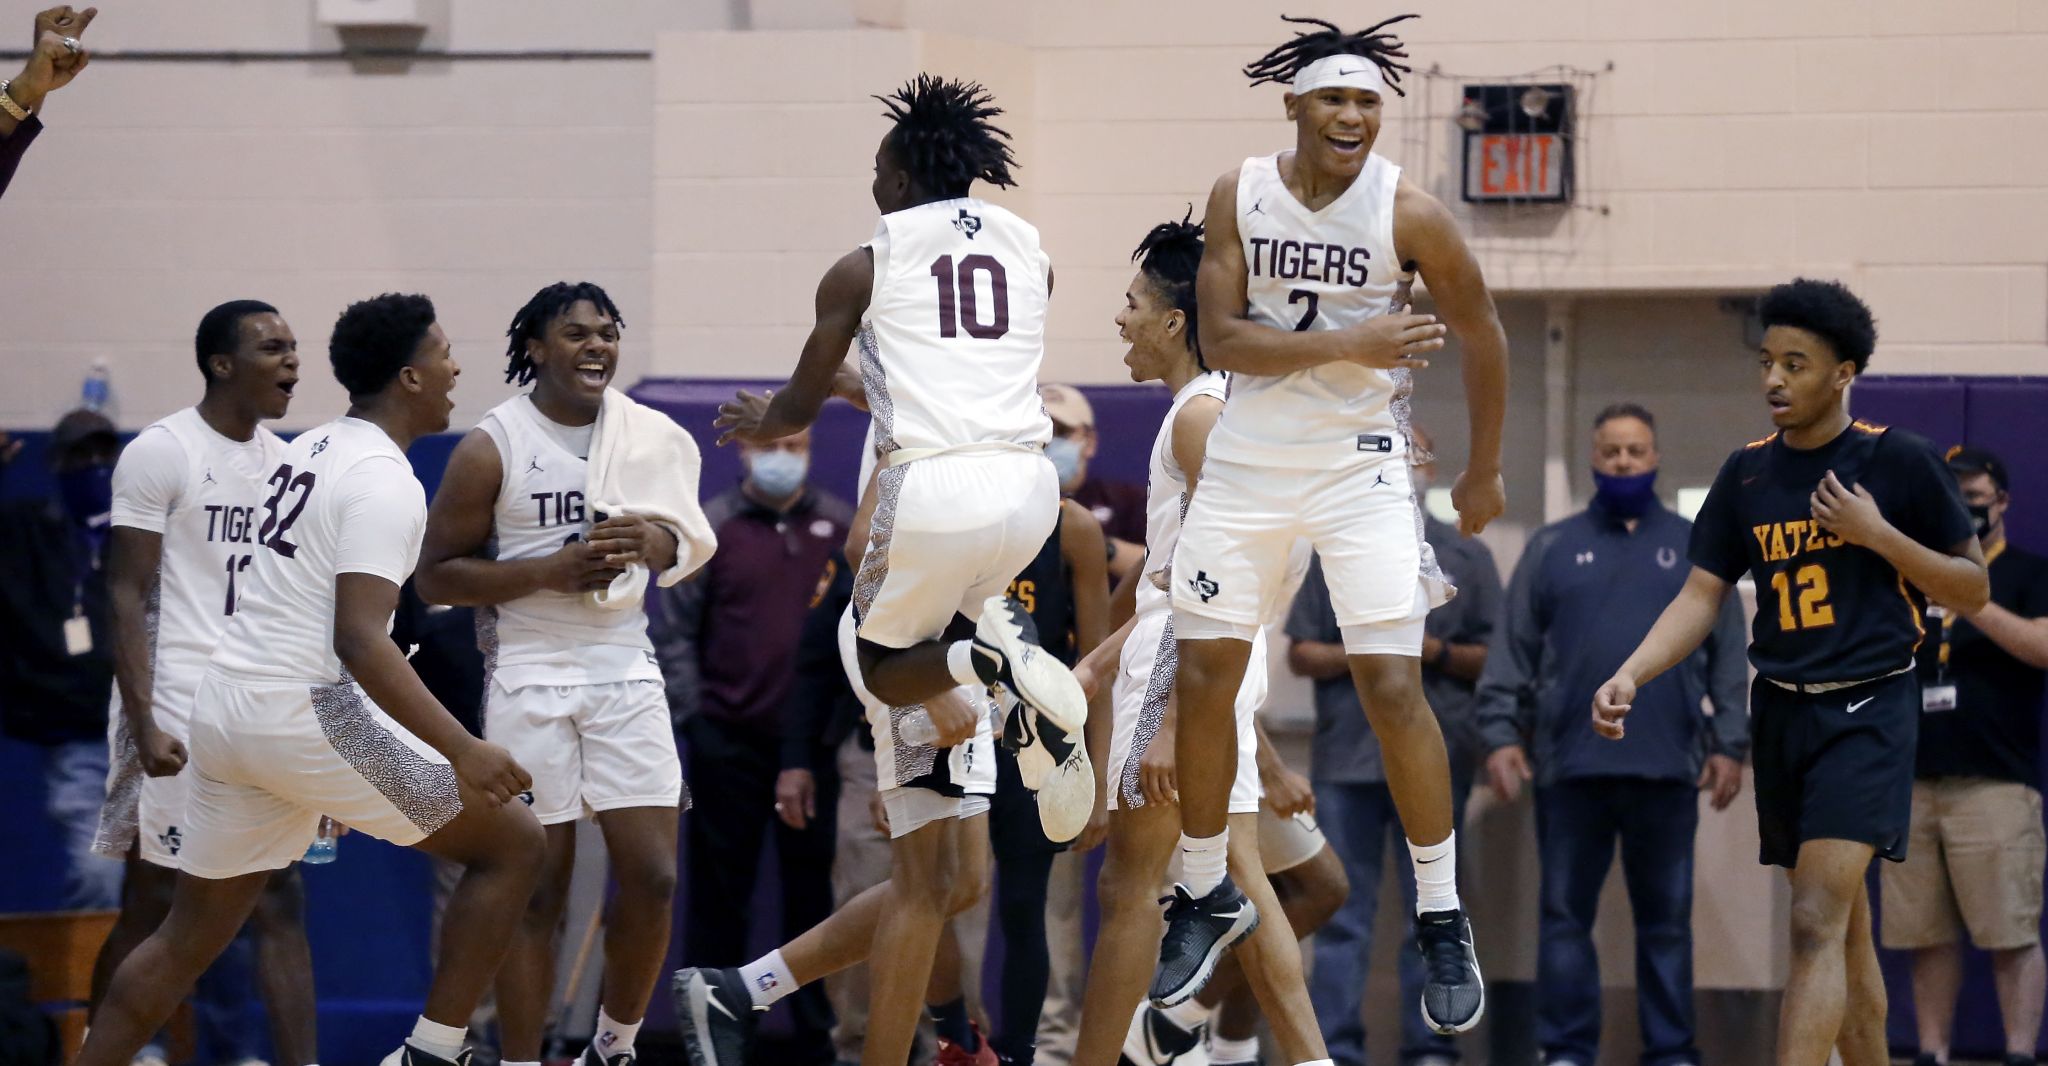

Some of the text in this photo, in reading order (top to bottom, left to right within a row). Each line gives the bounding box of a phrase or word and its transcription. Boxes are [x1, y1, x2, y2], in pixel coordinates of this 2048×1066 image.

[1482, 135, 1553, 193] EXIT
[1250, 237, 1371, 288] TIGERS
[930, 253, 1009, 339] 10
[1288, 288, 1319, 331] 2
[204, 505, 254, 543] TIGE
[258, 463, 316, 559] 32
[1771, 564, 1835, 631] 12
